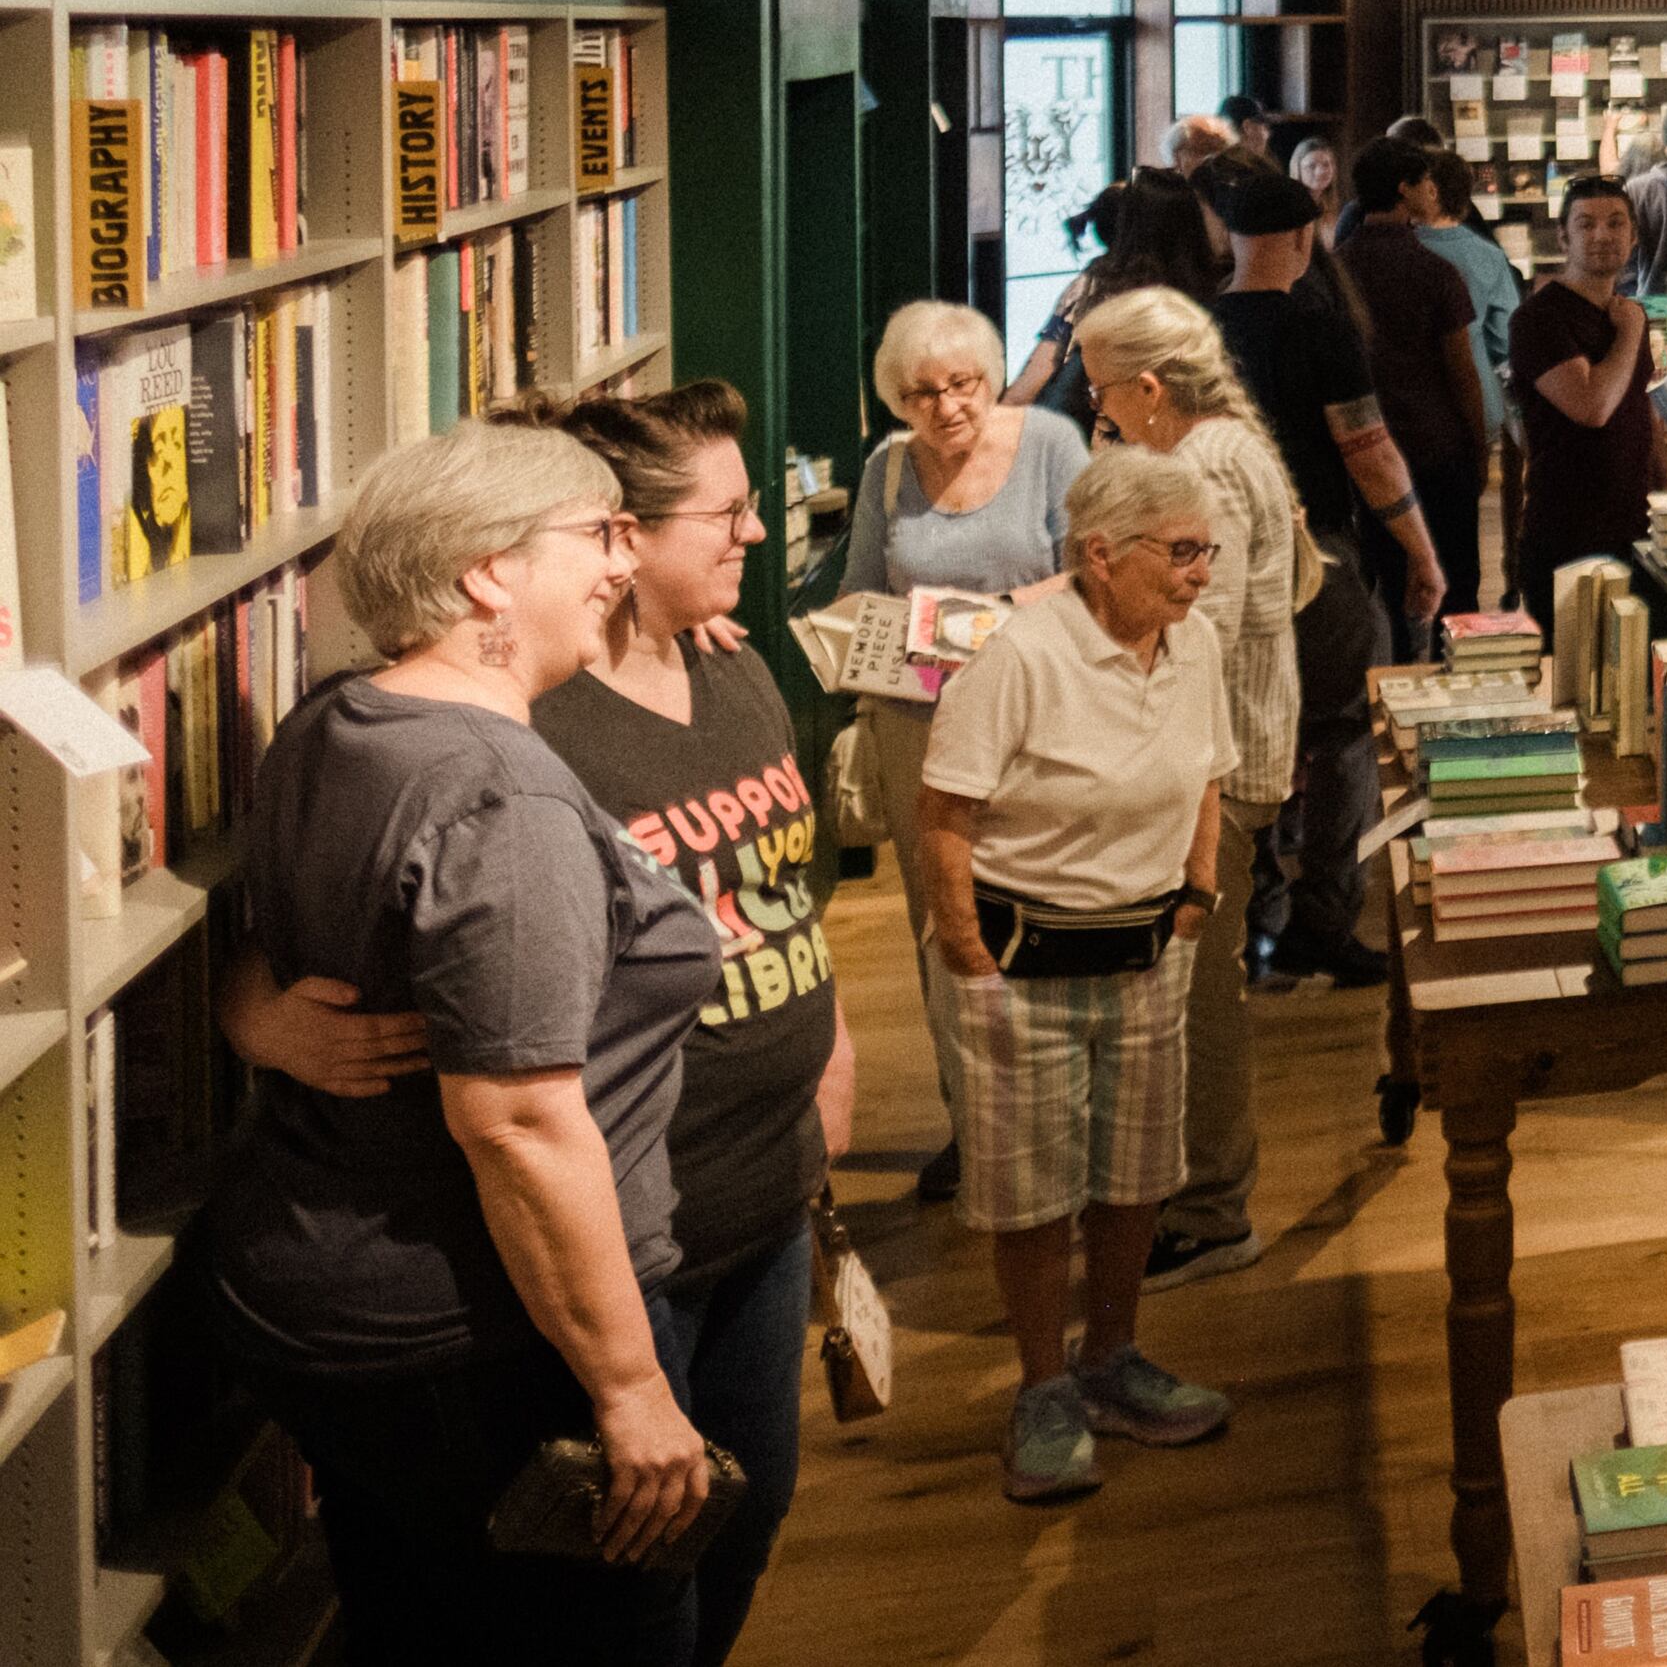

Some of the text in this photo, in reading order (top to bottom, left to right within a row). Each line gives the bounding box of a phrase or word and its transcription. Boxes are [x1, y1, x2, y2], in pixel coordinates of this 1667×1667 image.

[397, 90, 438, 227] HISTORY
[579, 78, 610, 178] EVENTS
[87, 103, 130, 311] BIOGRAPHY
[139, 368, 184, 404] REED
[846, 600, 879, 682] MEMORY
[866, 617, 893, 673] PIECE
[1616, 1471, 1647, 1498] ALL
